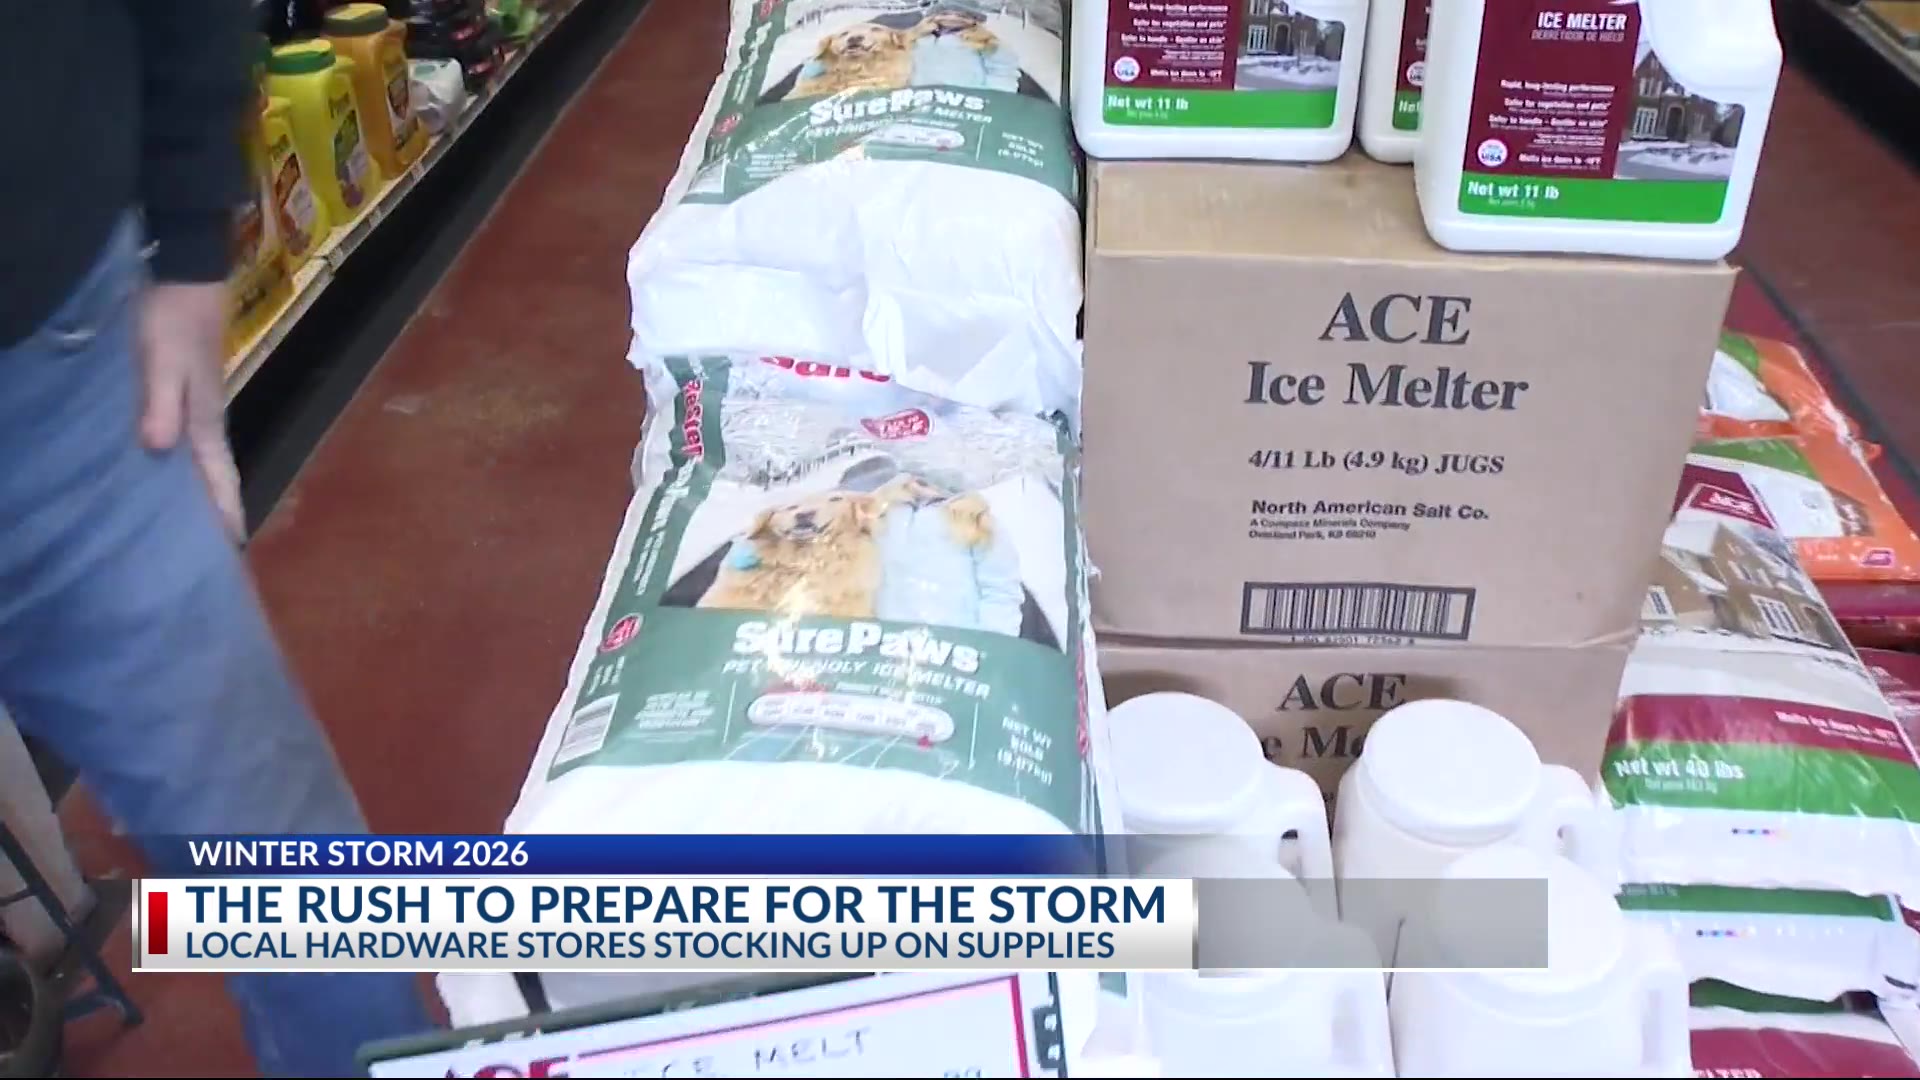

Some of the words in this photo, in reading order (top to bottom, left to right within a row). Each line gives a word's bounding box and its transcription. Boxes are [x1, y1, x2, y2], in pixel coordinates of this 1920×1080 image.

[1538, 11, 1563, 29] ICE
[1566, 12, 1627, 30] MELTER
[1108, 95, 1131, 109] Net
[1135, 96, 1153, 110] wt
[1157, 97, 1170, 110] 11
[1176, 98, 1189, 110] lb
[1467, 181, 1494, 196] Net
[1498, 183, 1519, 198] wt
[1524, 184, 1539, 198] 11
[1545, 186, 1560, 200] lb
[1318, 291, 1472, 346] ACE
[1244, 360, 1326, 406] Ice
[1343, 362, 1530, 411] Melter
[1248, 449, 1294, 470] 4/11
[1303, 450, 1336, 469] Lb
[1343, 450, 1385, 473] (4.9
[1391, 451, 1429, 476] kg)
[1434, 453, 1505, 476] JUGS
[1251, 500, 1307, 516] North
[1313, 500, 1407, 517] American
[1412, 502, 1452, 520] Salt
[1458, 505, 1490, 521] Co.
[1250, 518, 1260, 527] A
[1360, 518, 1412, 532] Company
[911, 669, 992, 701] MELTER
[1276, 672, 1407, 711] ACE
[1613, 756, 1650, 778] Net
[1651, 759, 1680, 777] wt
[1714, 759, 1746, 779] lbs
[754, 1029, 871, 1072] MELT
